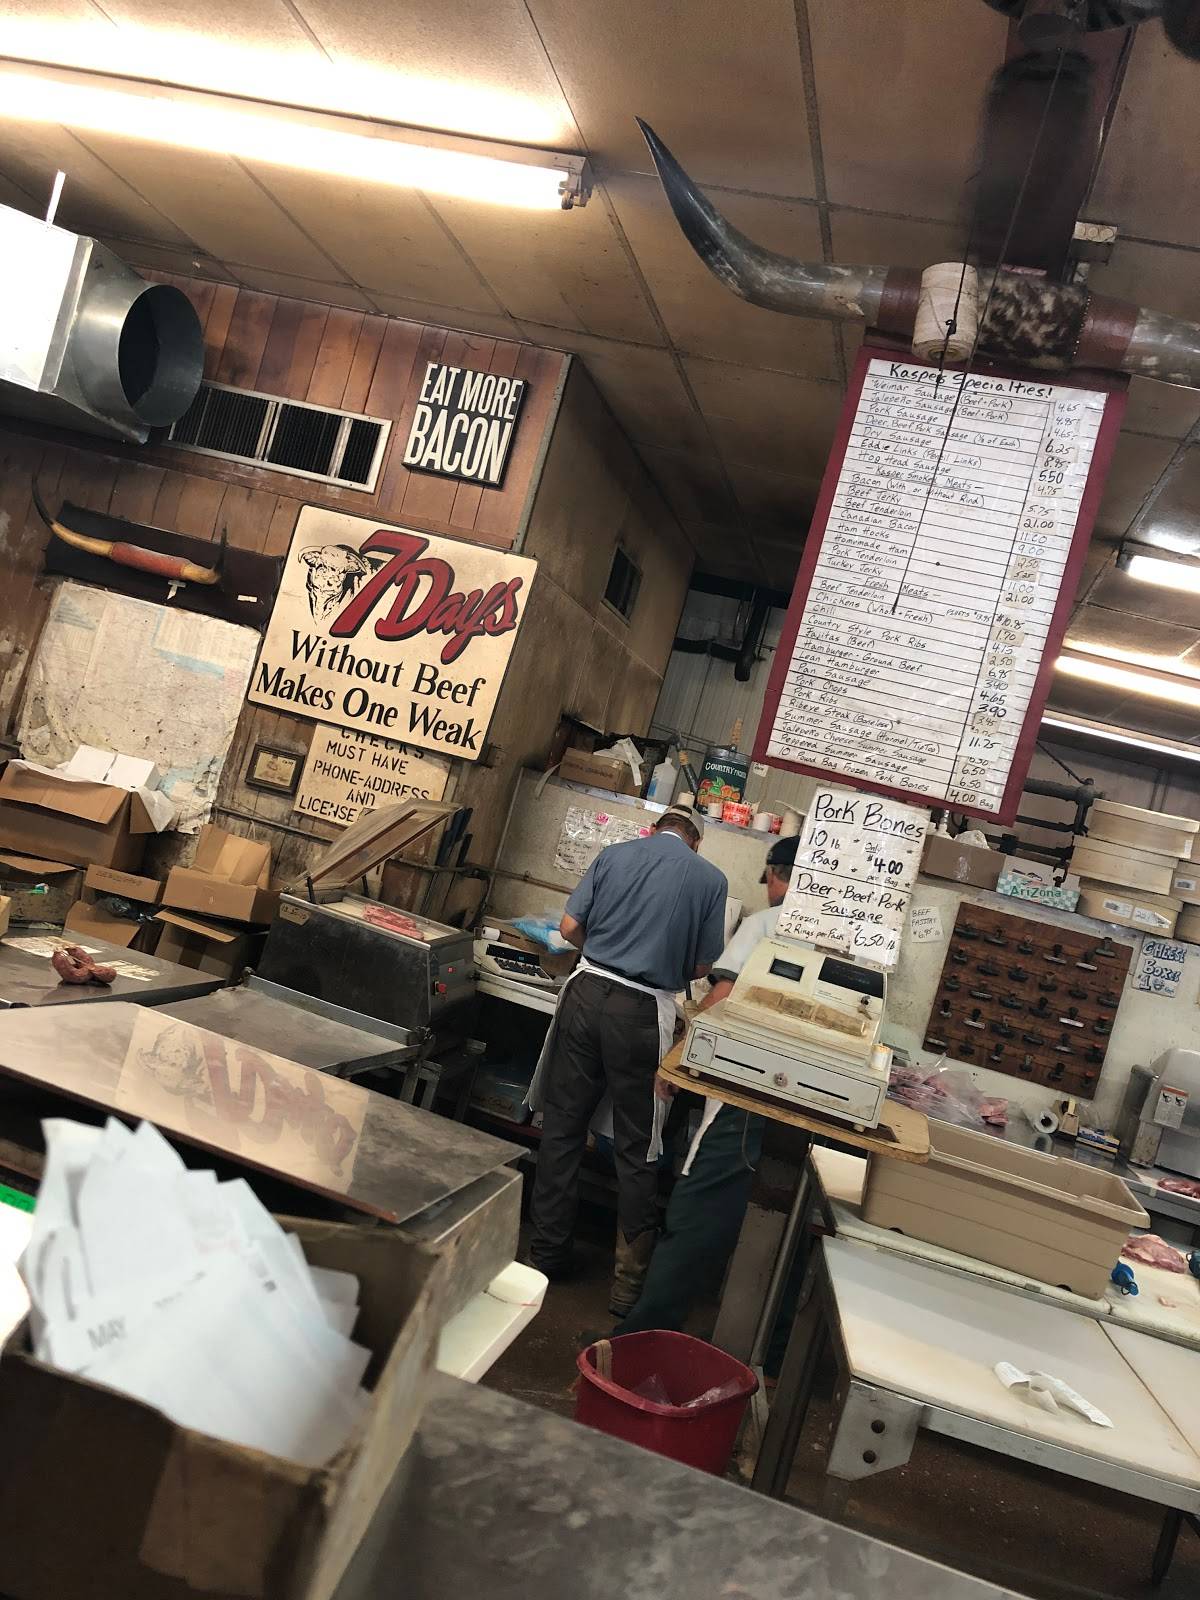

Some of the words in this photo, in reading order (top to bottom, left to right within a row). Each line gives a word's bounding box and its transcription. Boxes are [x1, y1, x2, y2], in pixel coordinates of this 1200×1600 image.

[420, 363, 461, 406] EAT
[458, 370, 523, 420] MORE
[913, 386, 955, 401] Sausage
[949, 373, 1053, 399] Specialties!
[869, 401, 892, 415] Pork
[894, 407, 938, 423] Sausage
[403, 404, 512, 482] BACON
[860, 438, 890, 450] Eddie
[893, 444, 917, 455] Links
[862, 426, 882, 437] Dry
[887, 431, 932, 447] Sausage
[856, 450, 880, 464] Hog
[884, 454, 909, 466] Head
[911, 460, 951, 476] Sausage
[851, 473, 881, 486] Bacon
[945, 477, 972, 489] Meats
[847, 484, 872, 496] Beef
[876, 490, 901, 503] Jerky
[844, 497, 868, 508] Beef
[870, 502, 911, 517] Tenderloin
[837, 522, 857, 532] Ham
[862, 526, 889, 539] Hocks
[840, 509, 882, 524] Canadian
[888, 518, 917, 531] Bacon
[831, 544, 850, 556] Pork
[855, 549, 896, 565] Tenderloin
[888, 544, 907, 554] Ham
[826, 556, 854, 569] Turkey
[859, 563, 883, 575] Jerky
[329, 529, 429, 638] 7
[819, 579, 840, 591] Beef
[846, 585, 884, 600] Tenderloin
[863, 575, 890, 589] Fresh
[901, 584, 929, 596] Meats
[815, 591, 860, 608] Chickens
[374, 557, 523, 665] Days
[807, 615, 841, 630] Country
[846, 624, 871, 638] Style
[880, 630, 900, 642] Pork
[906, 636, 926, 648] Ribs
[798, 650, 820, 662] Lean
[826, 656, 879, 675] Hamburger
[802, 639, 853, 657] Hamburger
[861, 652, 893, 666] Ground
[897, 660, 923, 671] Beef
[291, 630, 404, 688] Without
[411, 663, 487, 708] Beef
[797, 662, 815, 674] Pan
[823, 669, 871, 687] Sausage
[795, 674, 816, 687] Pork
[822, 680, 848, 693] Chops
[793, 686, 812, 699] Pork
[818, 692, 838, 704] Ribs
[255, 663, 336, 710] Makes
[342, 687, 399, 728] One
[408, 702, 483, 751] Weak
[788, 697, 819, 712] Ribeye
[824, 707, 850, 719] Steak
[784, 709, 823, 724] Summer
[828, 720, 872, 738] Sausage
[325, 740, 367, 762] MUST
[371, 752, 409, 775] HAVE
[780, 733, 818, 748] Peppered
[824, 744, 857, 758] Summer
[864, 754, 907, 774] Sausage
[823, 731, 854, 744] Cheese
[857, 740, 887, 754] Summer
[891, 748, 926, 765] Sausage
[313, 759, 430, 800] PHONE-ADDRESS
[797, 750, 816, 763] Pound
[821, 756, 837, 769] Bag
[842, 762, 868, 776] Frozen
[874, 770, 894, 782] Pork
[899, 776, 928, 791] Bones
[299, 795, 357, 822] LICENSE
[814, 793, 860, 821] Pork
[863, 802, 925, 838] Bones
[808, 827, 828, 846] 10
[811, 850, 839, 870] Bag
[796, 872, 836, 895] Deer
[878, 892, 906, 912] Pork
[884, 877, 898, 887] Bag
[793, 923, 814, 938] Rings
